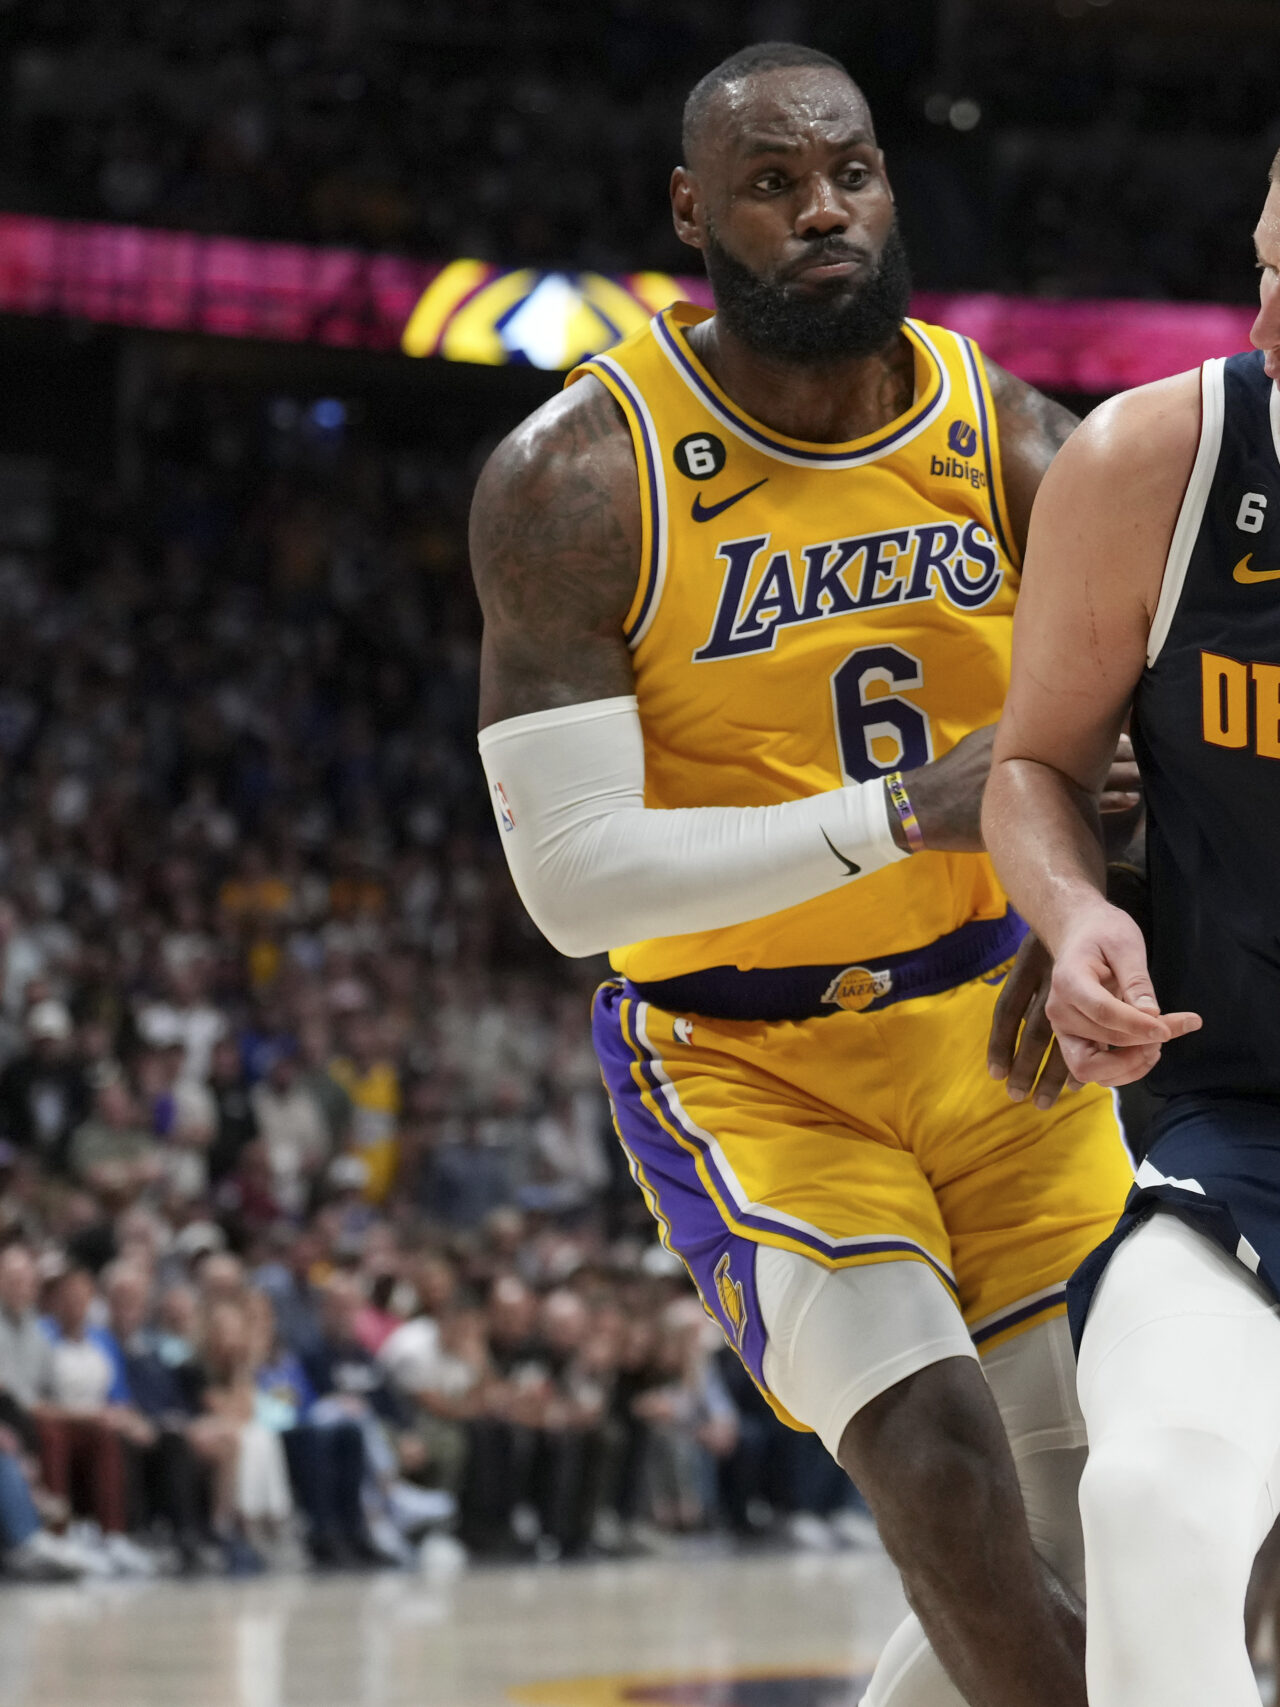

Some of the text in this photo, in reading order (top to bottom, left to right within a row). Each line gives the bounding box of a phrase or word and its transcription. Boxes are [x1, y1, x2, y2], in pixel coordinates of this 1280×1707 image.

[684, 439, 716, 476] 6
[1235, 491, 1269, 534] 6
[691, 519, 1004, 664] LAKERS
[830, 643, 935, 788] 6
